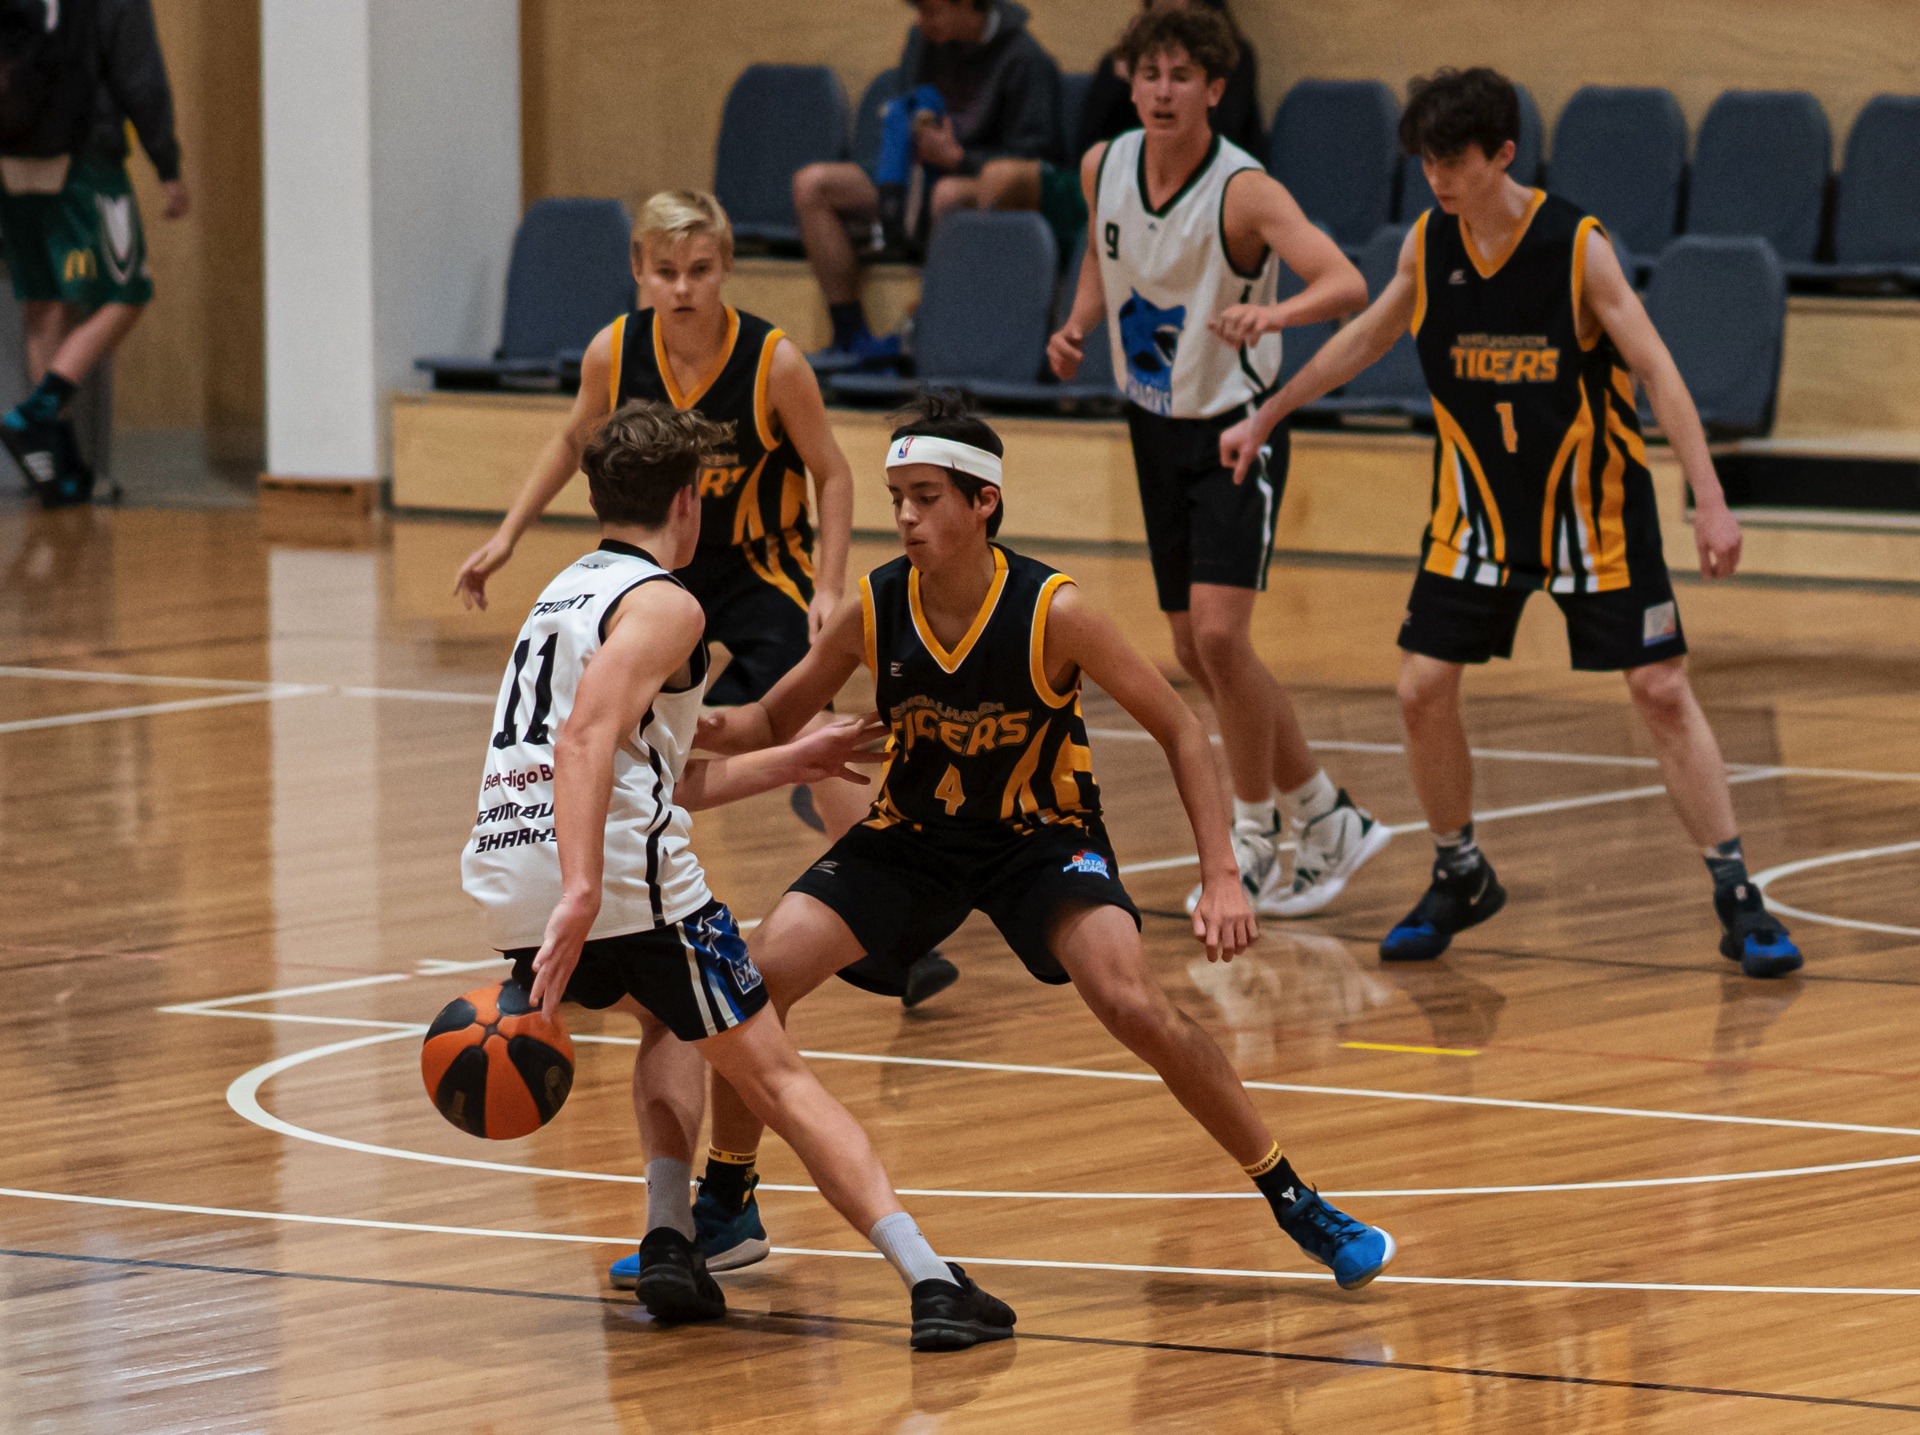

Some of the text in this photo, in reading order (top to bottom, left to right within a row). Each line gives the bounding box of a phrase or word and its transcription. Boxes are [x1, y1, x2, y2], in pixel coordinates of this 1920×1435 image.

[1104, 221, 1120, 261] 9
[1494, 402, 1519, 454] 1
[492, 631, 559, 751] 11
[934, 762, 967, 817] 4
